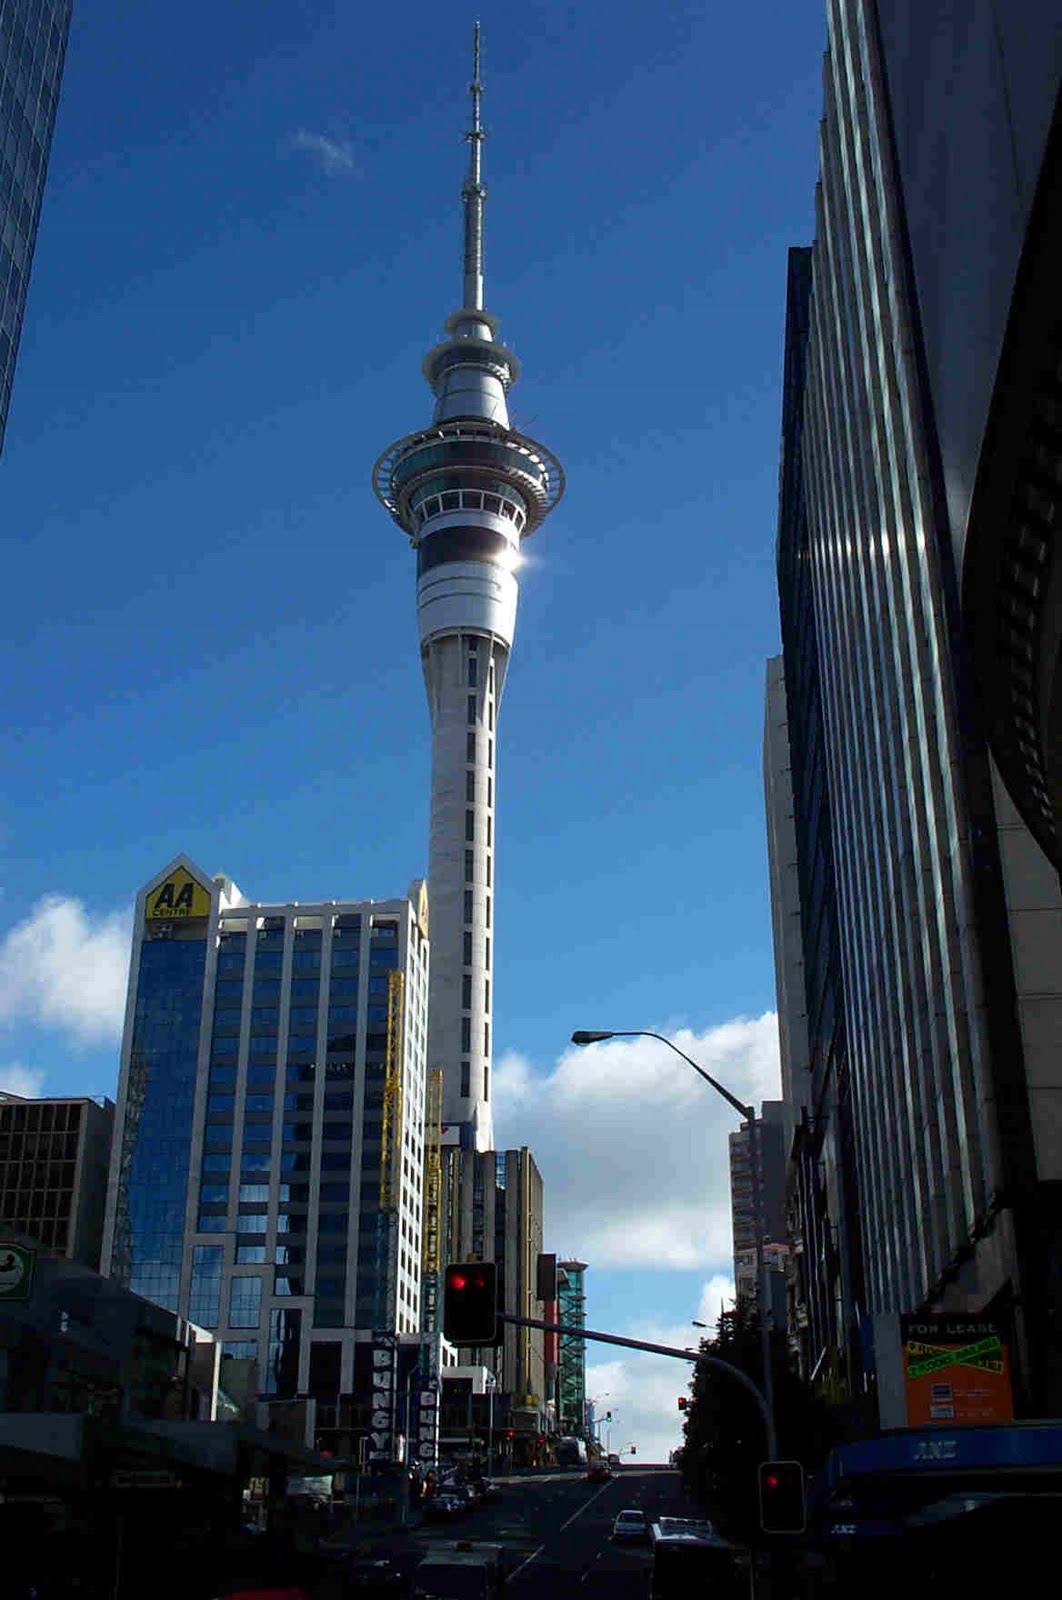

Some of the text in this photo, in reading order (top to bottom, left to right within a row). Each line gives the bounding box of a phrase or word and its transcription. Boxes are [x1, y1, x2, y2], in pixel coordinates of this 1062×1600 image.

[154, 883, 193, 909] AA
[152, 908, 190, 917] CENTRE
[908, 1321, 997, 1336] FOR LEASE
[370, 1349, 393, 1449] BUNGY
